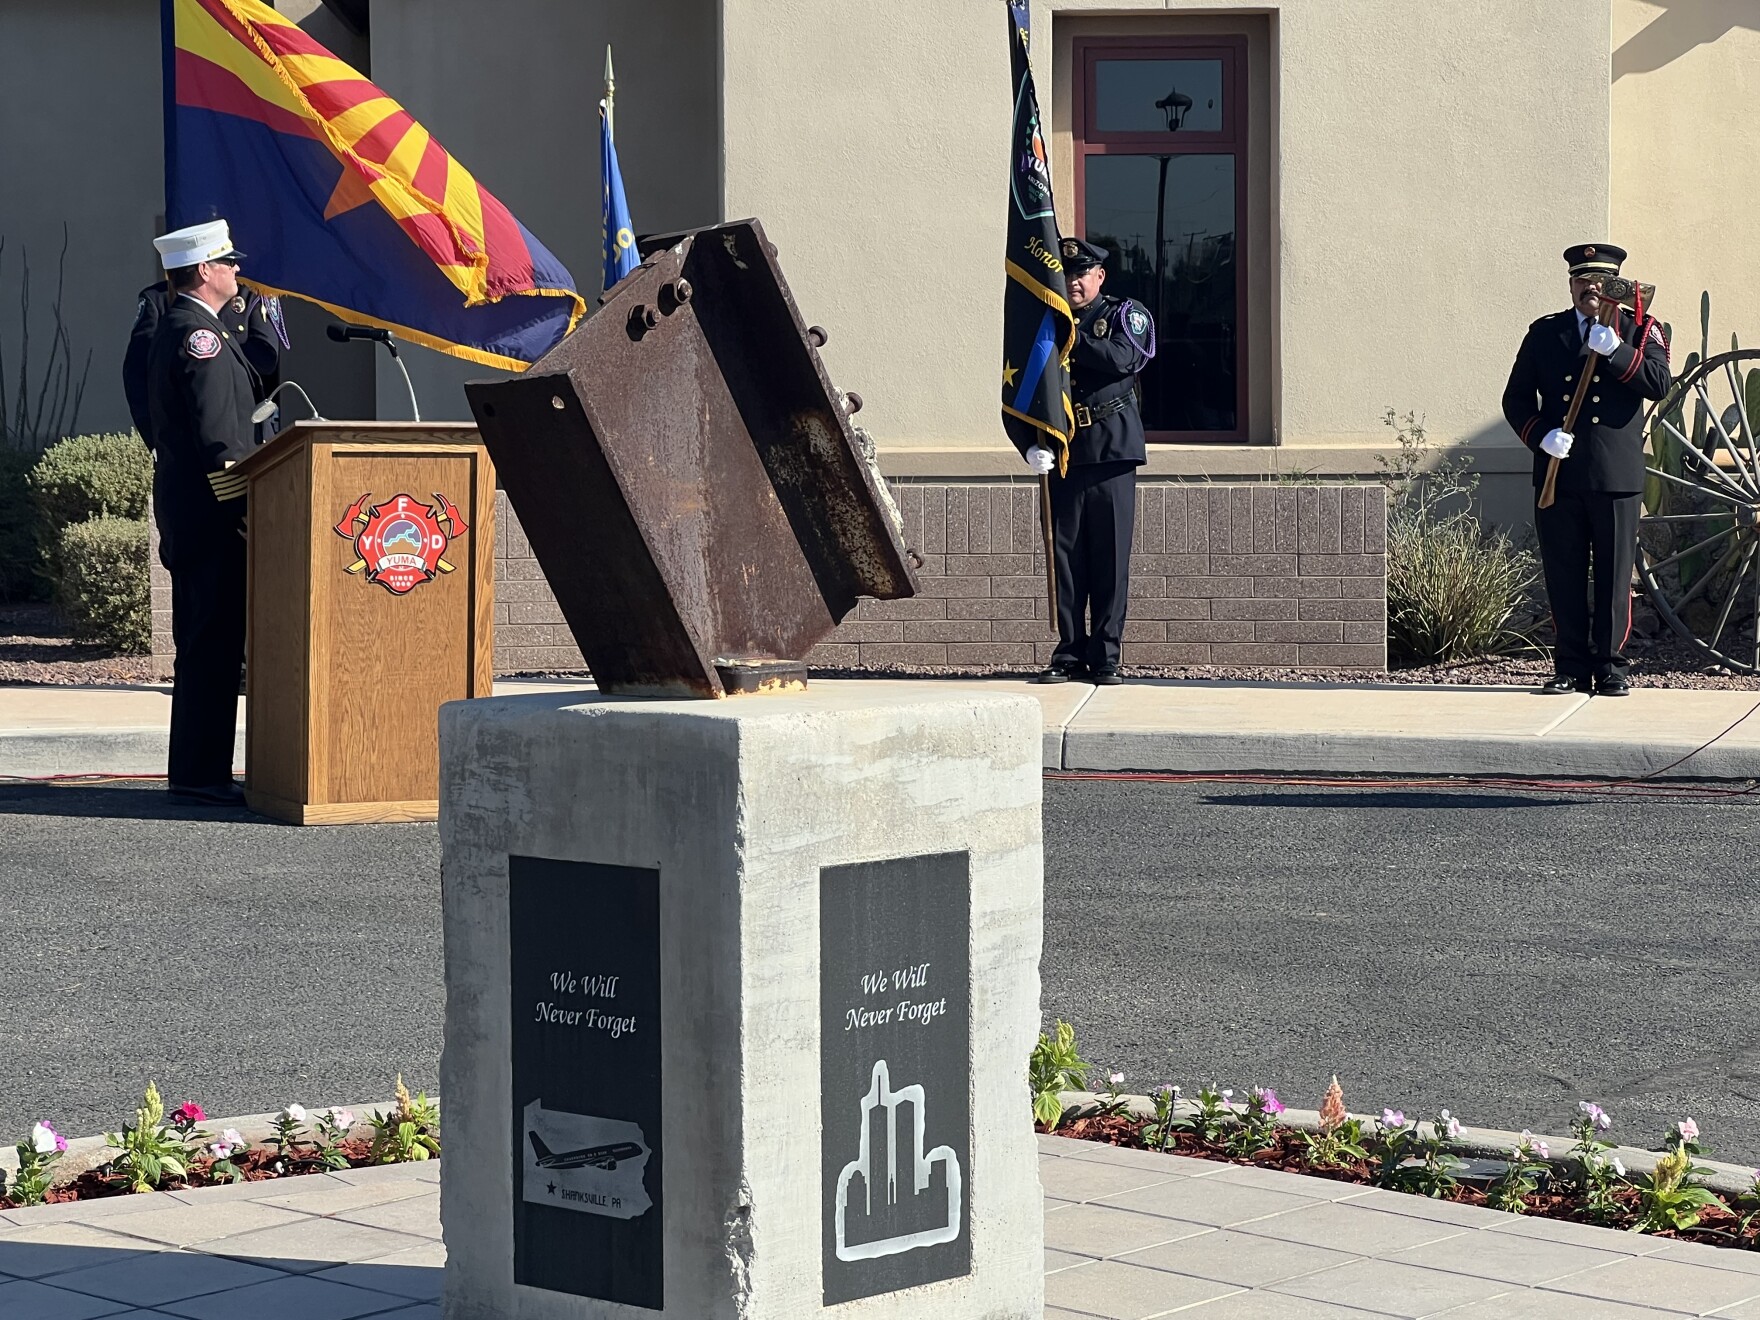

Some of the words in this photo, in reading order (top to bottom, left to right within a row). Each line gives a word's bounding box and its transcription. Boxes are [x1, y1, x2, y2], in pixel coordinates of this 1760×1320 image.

[1023, 236, 1064, 273] Honor
[362, 535, 373, 550] Y
[397, 498, 408, 512] F
[431, 535, 443, 549] D
[386, 555, 417, 566] YUMA
[550, 970, 577, 994] We
[581, 974, 619, 998] Will
[860, 969, 888, 996] We
[892, 963, 931, 991] Will
[535, 1001, 582, 1026] Never
[586, 1008, 637, 1039] Forget
[844, 1006, 894, 1031] Never
[896, 997, 947, 1025] Forget
[611, 1197, 622, 1209] PA
